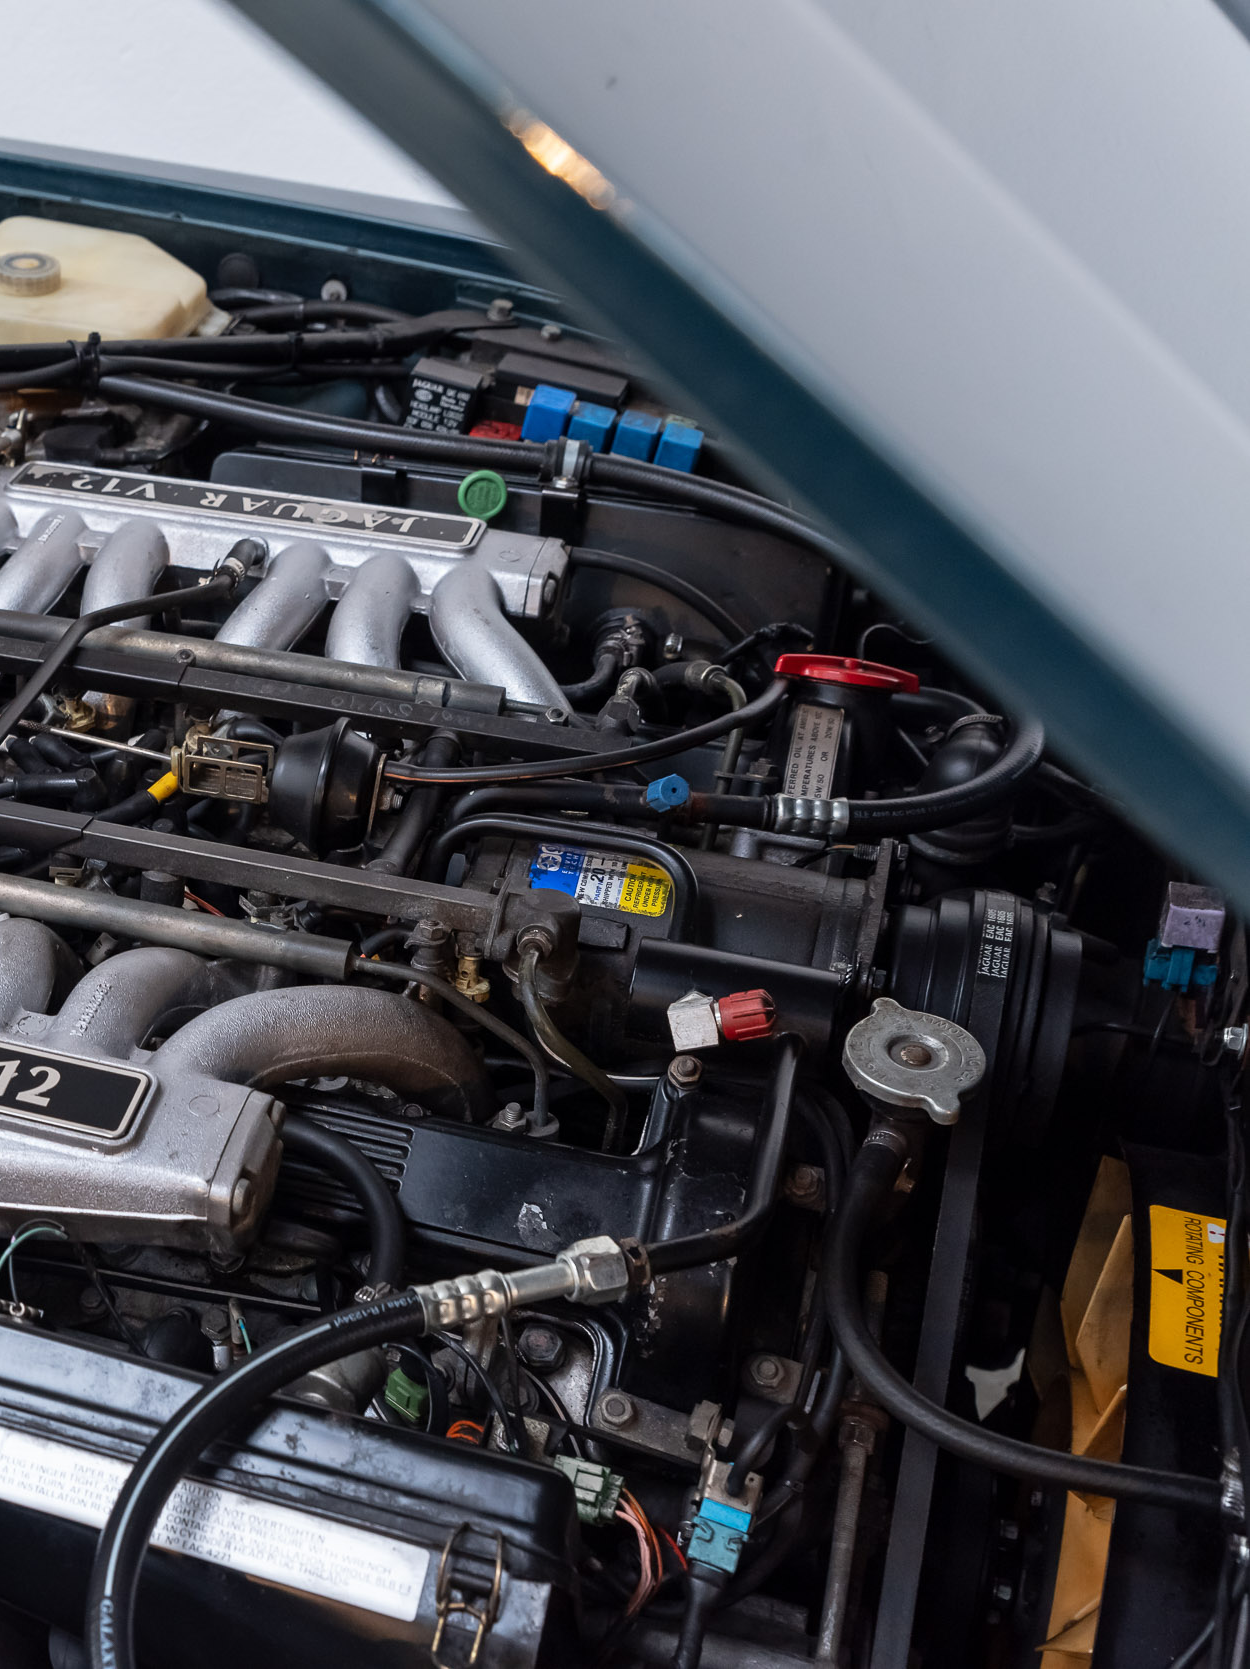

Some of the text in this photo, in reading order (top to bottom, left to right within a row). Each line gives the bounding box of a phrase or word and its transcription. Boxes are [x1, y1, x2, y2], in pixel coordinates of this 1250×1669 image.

[70, 475, 419, 533] JAGUAR V12
[794, 746, 802, 758] OIL
[798, 731, 804, 740] AT
[811, 721, 820, 742] ABOVE
[821, 750, 828, 761] OR
[590, 866, 606, 883] 20
[624, 873, 637, 902] CAUTION
[594, 884, 602, 900] PART
[642, 887, 652, 907] UNDER
[985, 923, 995, 939] EAC
[995, 925, 1005, 941] EAC
[981, 943, 994, 975] JAGUAR
[991, 945, 1003, 977] JAGUAR
[1000, 946, 1010, 978] JAGUAR
[1183, 1216, 1206, 1365] ROTATING COMPONENTS
[29, 1462, 67, 1479] FINGER
[69, 1472, 100, 1488] TIGHT
[36, 1475, 65, 1490] TURN
[68, 1484, 103, 1501] AFTER
[15, 1479, 88, 1508] INSTALLATION
[172, 1492, 327, 1545] PLUG DO NOT OVERTIGHTEN
[180, 1539, 204, 1554] EAC
[204, 1546, 232, 1563] 4271
[247, 1525, 305, 1550] PRESSURE
[306, 1543, 339, 1561] WITH
[340, 1553, 393, 1576] WRENCH
[247, 1537, 326, 1569] INSTALLATION
